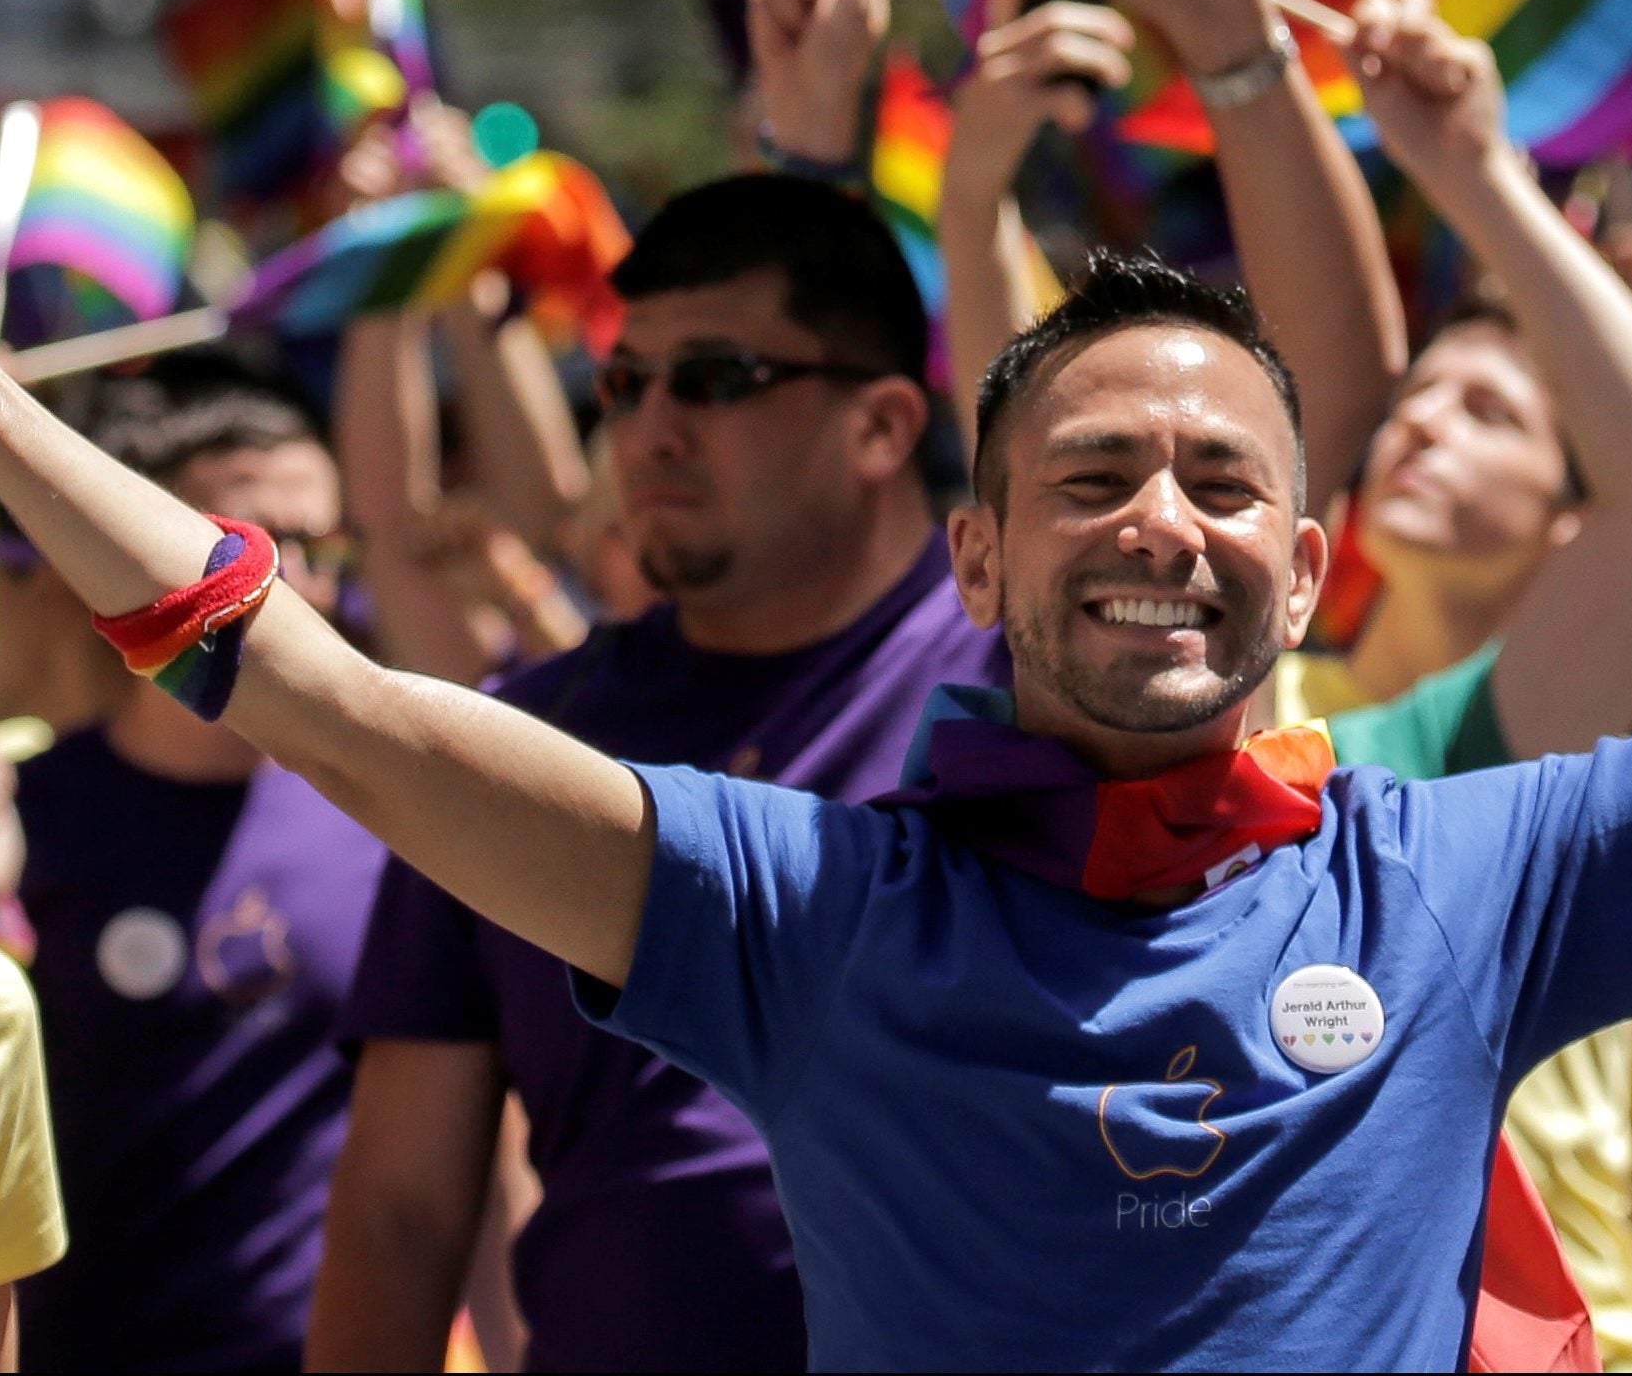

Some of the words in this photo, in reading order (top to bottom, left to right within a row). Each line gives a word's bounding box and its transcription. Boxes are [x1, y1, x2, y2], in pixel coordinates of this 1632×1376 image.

[1281, 1001, 1323, 1013] Jerald
[1326, 1000, 1367, 1011] Arthur
[1304, 1015, 1349, 1029] Wright
[1117, 1191, 1212, 1230] Pride
